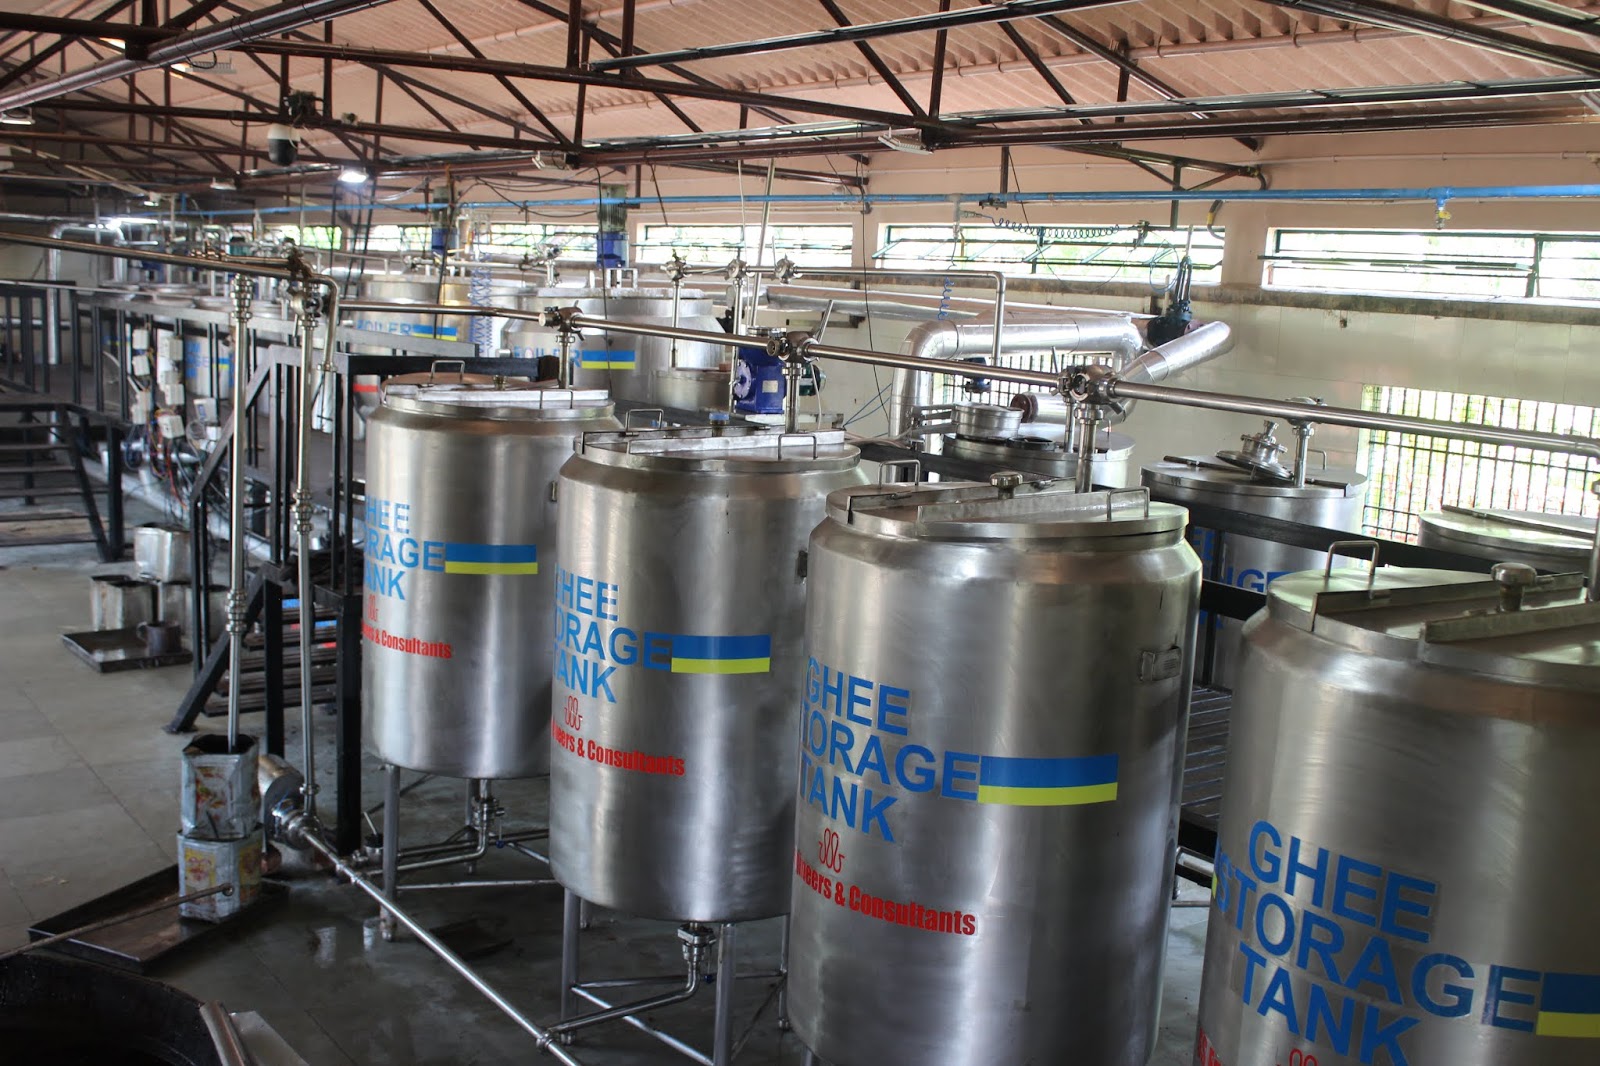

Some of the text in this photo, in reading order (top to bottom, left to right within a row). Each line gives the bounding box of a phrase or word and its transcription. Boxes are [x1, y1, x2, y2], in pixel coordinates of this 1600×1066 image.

[364, 495, 410, 535] HEE
[364, 524, 445, 573] RAGE
[364, 559, 406, 600] ANK
[557, 565, 618, 622] HEE
[381, 630, 453, 660] Consultants
[554, 606, 671, 671] ORAGE
[806, 655, 910, 737] GHEE
[577, 738, 585, 758] &
[587, 740, 685, 776] Consultants
[835, 882, 846, 906] &
[849, 885, 976, 936] Consultants
[1249, 820, 1437, 943] GHEE
[1215, 852, 1541, 1032] STORAGE
[1239, 940, 1421, 1066] TANK
